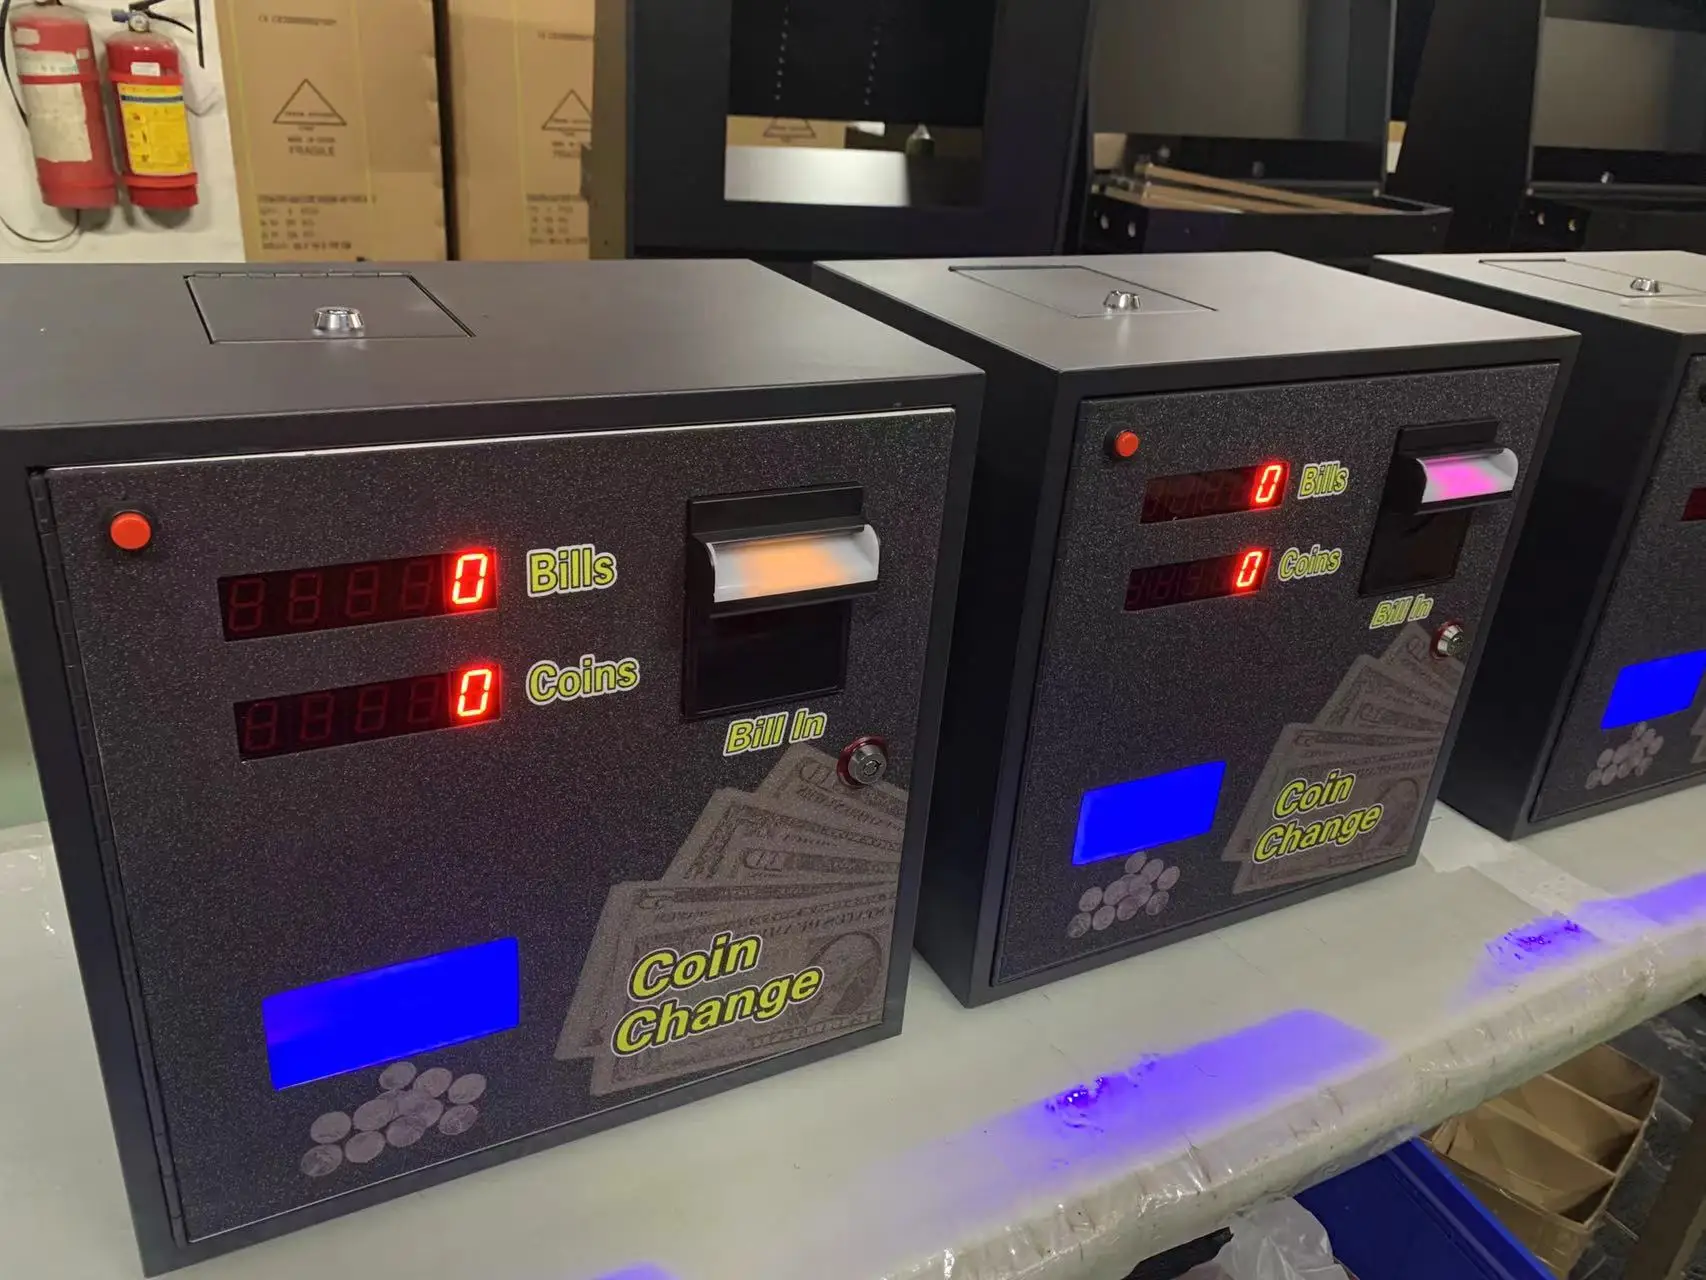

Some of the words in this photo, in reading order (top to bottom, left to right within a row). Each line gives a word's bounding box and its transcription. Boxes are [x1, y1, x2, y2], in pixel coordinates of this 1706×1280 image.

[1255, 464, 1282, 504] 0
[1298, 461, 1349, 498] Bills
[451, 553, 489, 604] 0
[528, 545, 616, 597] Bills
[1235, 550, 1263, 588] 0
[1278, 545, 1342, 581] Coins
[1370, 597, 1413, 628] Bill
[1408, 595, 1433, 621] In
[456, 668, 493, 717] 0
[527, 655, 640, 704] Coins
[723, 710, 785, 756] Bill
[792, 708, 827, 739] In
[1273, 769, 1356, 820] Coin
[1252, 804, 1384, 864] Change
[628, 932, 762, 1001] Coin
[611, 966, 824, 1057] Change
